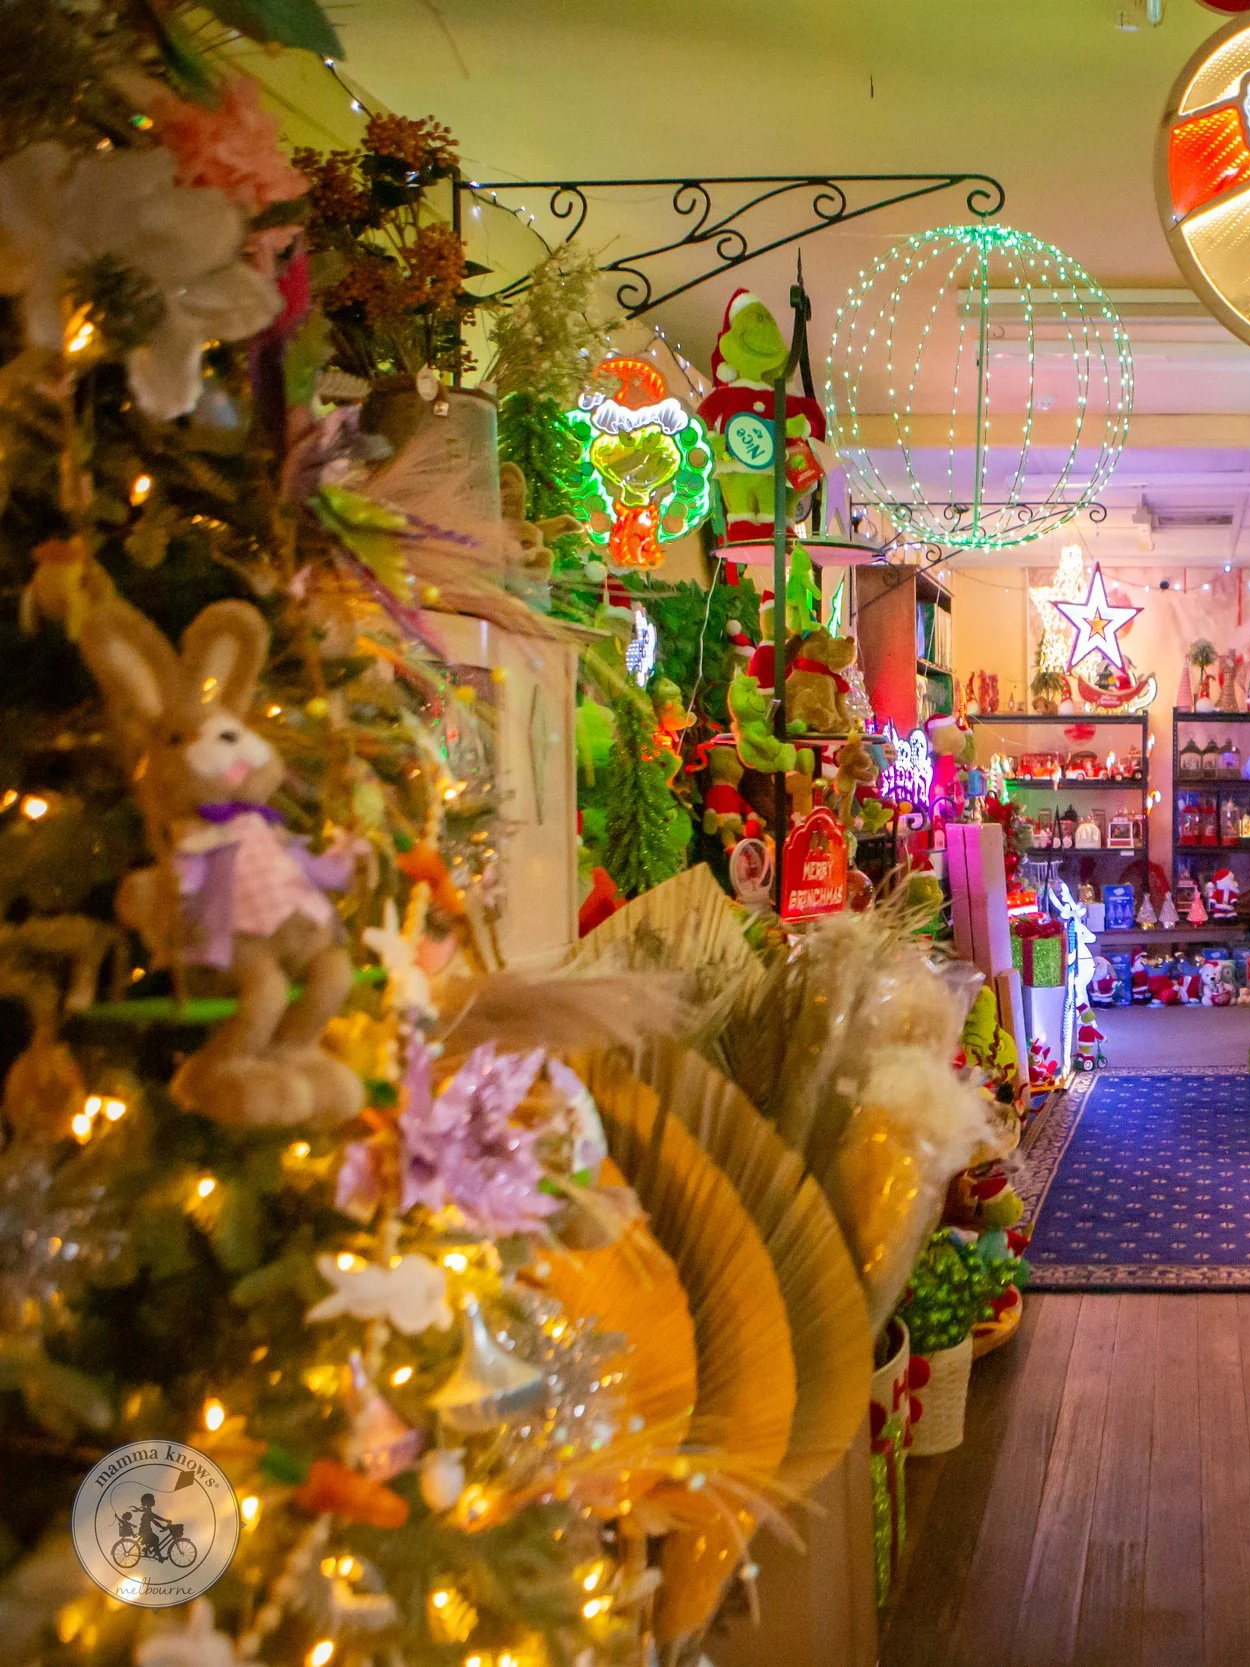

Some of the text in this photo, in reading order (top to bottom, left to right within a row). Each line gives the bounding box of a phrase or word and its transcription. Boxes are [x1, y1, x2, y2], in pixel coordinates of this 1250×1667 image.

[736, 428, 766, 460] Nice
[803, 860, 833, 881] MERRY
[788, 884, 843, 910] GRINCHMAS
